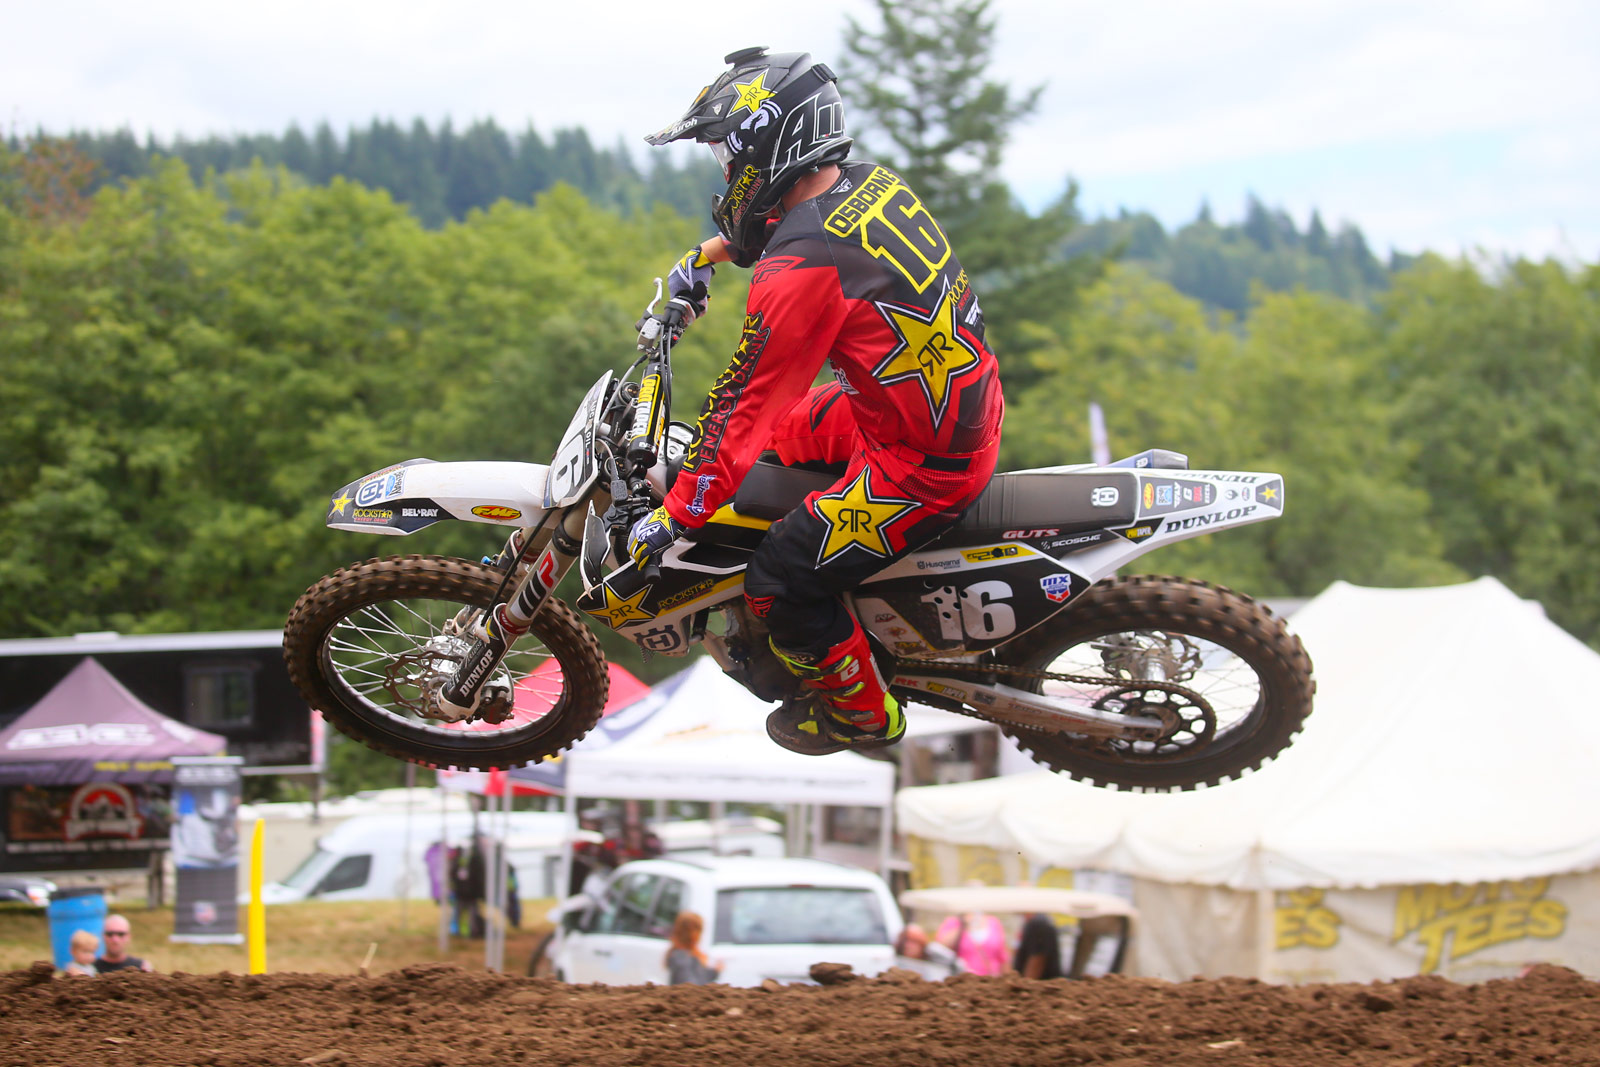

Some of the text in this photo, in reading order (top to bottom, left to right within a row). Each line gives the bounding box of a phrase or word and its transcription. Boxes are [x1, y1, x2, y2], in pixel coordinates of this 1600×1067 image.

[827, 168, 898, 234] OSBORNE
[860, 185, 952, 295] 16
[699, 330, 768, 460] ENERGY DRINK
[1002, 528, 1060, 540] GUTS
[1051, 533, 1101, 548] SCOSCHE
[1164, 505, 1258, 533] DUNLOP
[920, 580, 1017, 640] 16
[459, 649, 494, 697] DUNLOP
[1416, 898, 1570, 977] TEES
